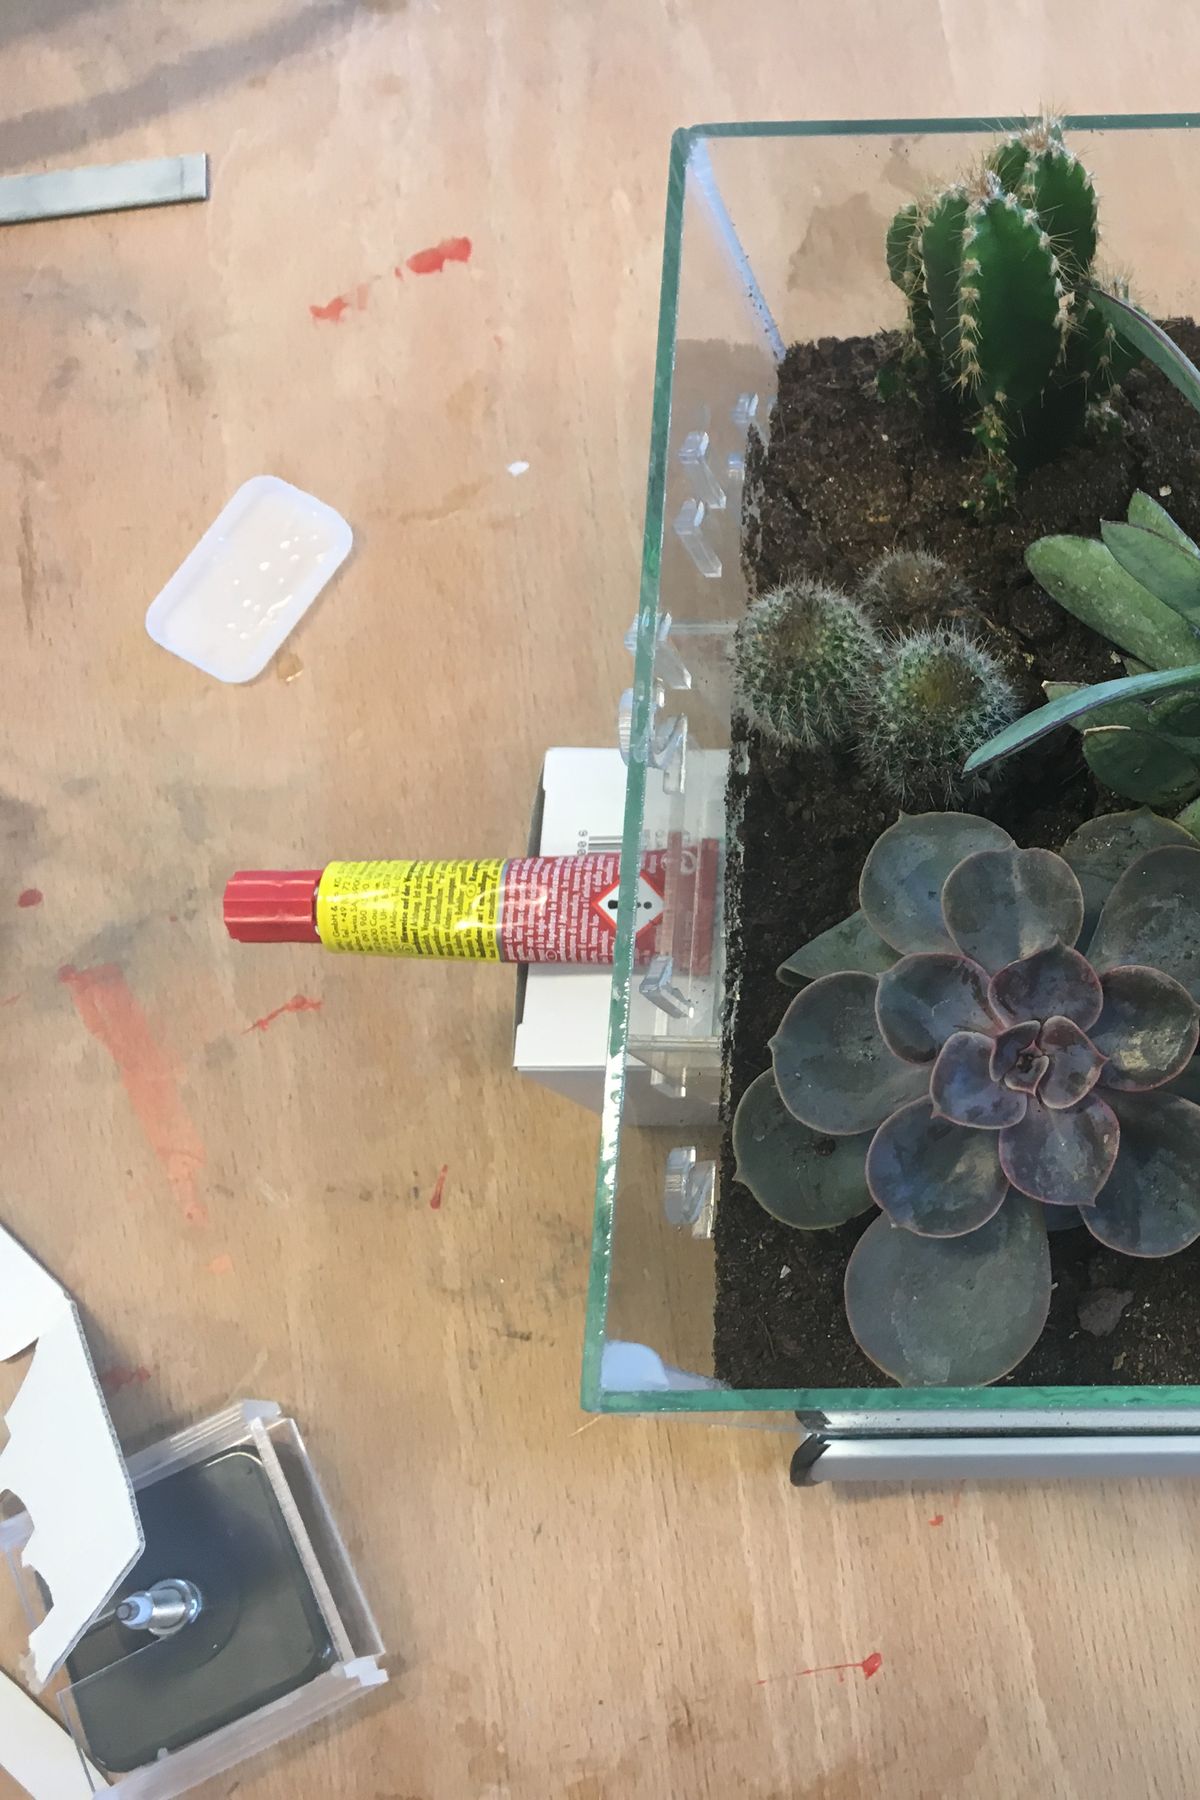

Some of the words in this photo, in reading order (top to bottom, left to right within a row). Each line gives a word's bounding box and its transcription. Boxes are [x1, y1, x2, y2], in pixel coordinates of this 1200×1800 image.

[569, 893, 581, 917] medico,
[545, 911, 557, 948] Rispettare
[580, 909, 589, 943] contenitore
[588, 927, 598, 947] Tenere
